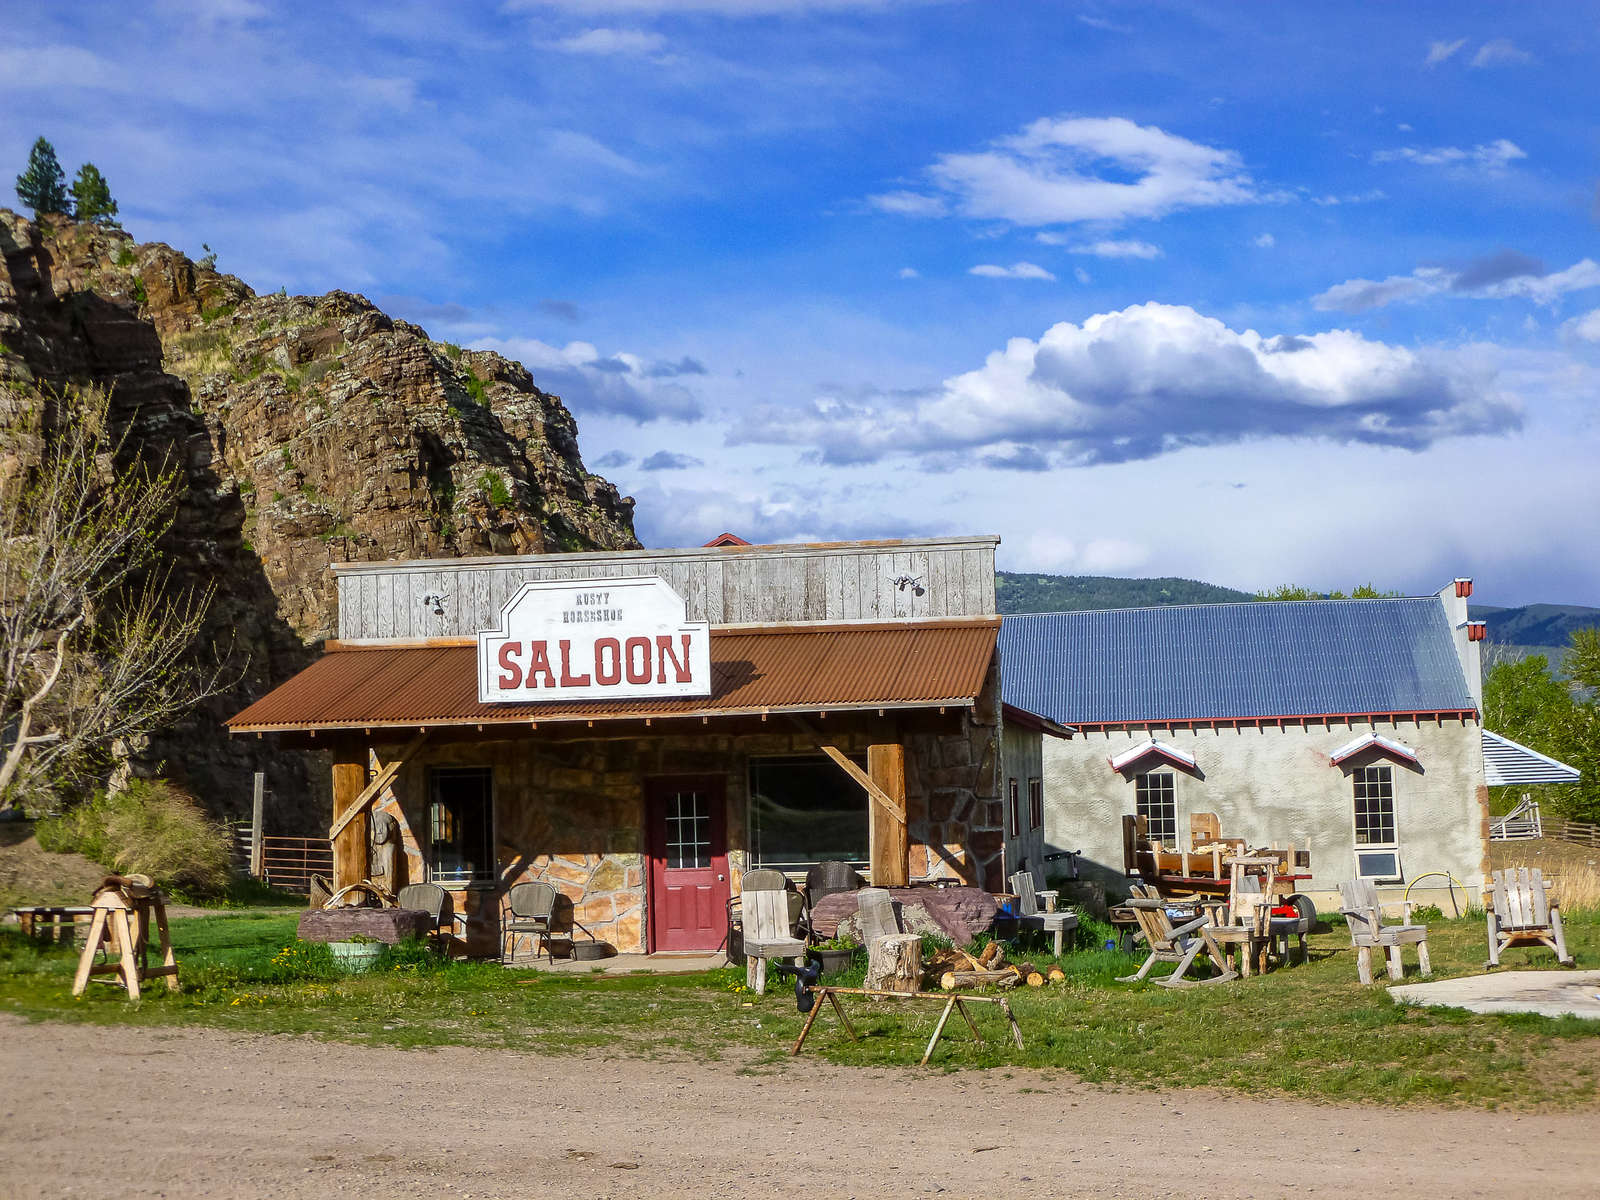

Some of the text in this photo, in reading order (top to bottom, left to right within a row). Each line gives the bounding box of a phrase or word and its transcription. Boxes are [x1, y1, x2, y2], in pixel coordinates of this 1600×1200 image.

[576, 592, 610, 606] RUSTY
[563, 609, 623, 624] HORSESHOE
[498, 634, 692, 689] SALOON
